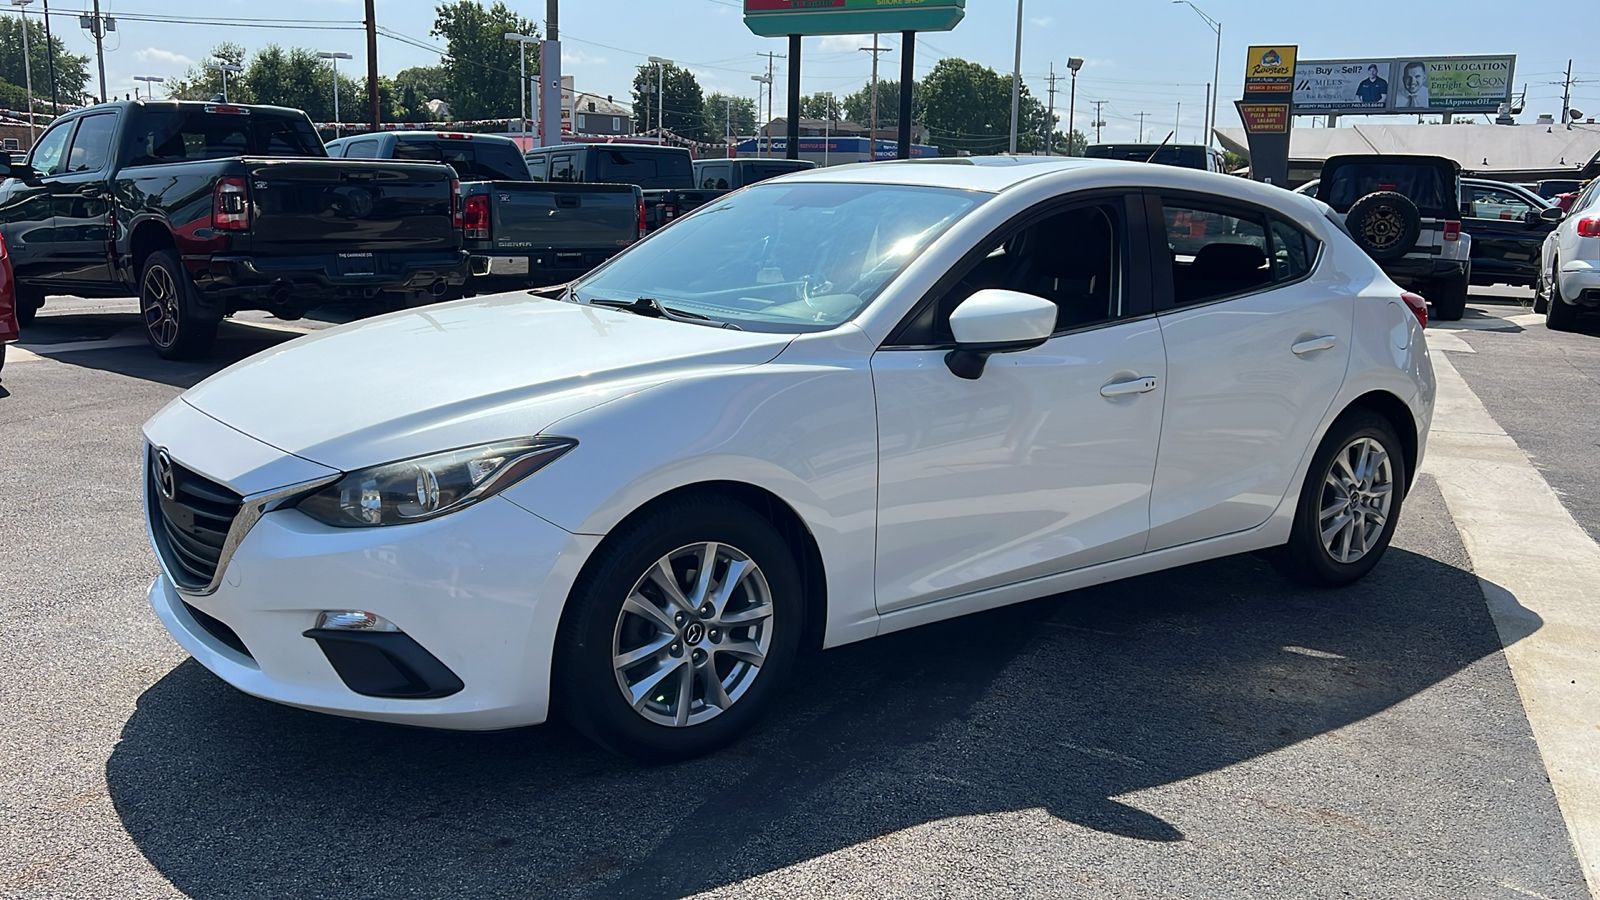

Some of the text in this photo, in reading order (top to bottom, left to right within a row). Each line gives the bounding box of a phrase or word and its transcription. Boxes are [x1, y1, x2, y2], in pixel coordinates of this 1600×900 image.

[1252, 64, 1289, 76] Roosters
[1316, 67, 1333, 75] Buy
[1342, 66, 1363, 74] Sell?
[1455, 62, 1508, 71] LOCATION
[1431, 81, 1462, 90] Enright
